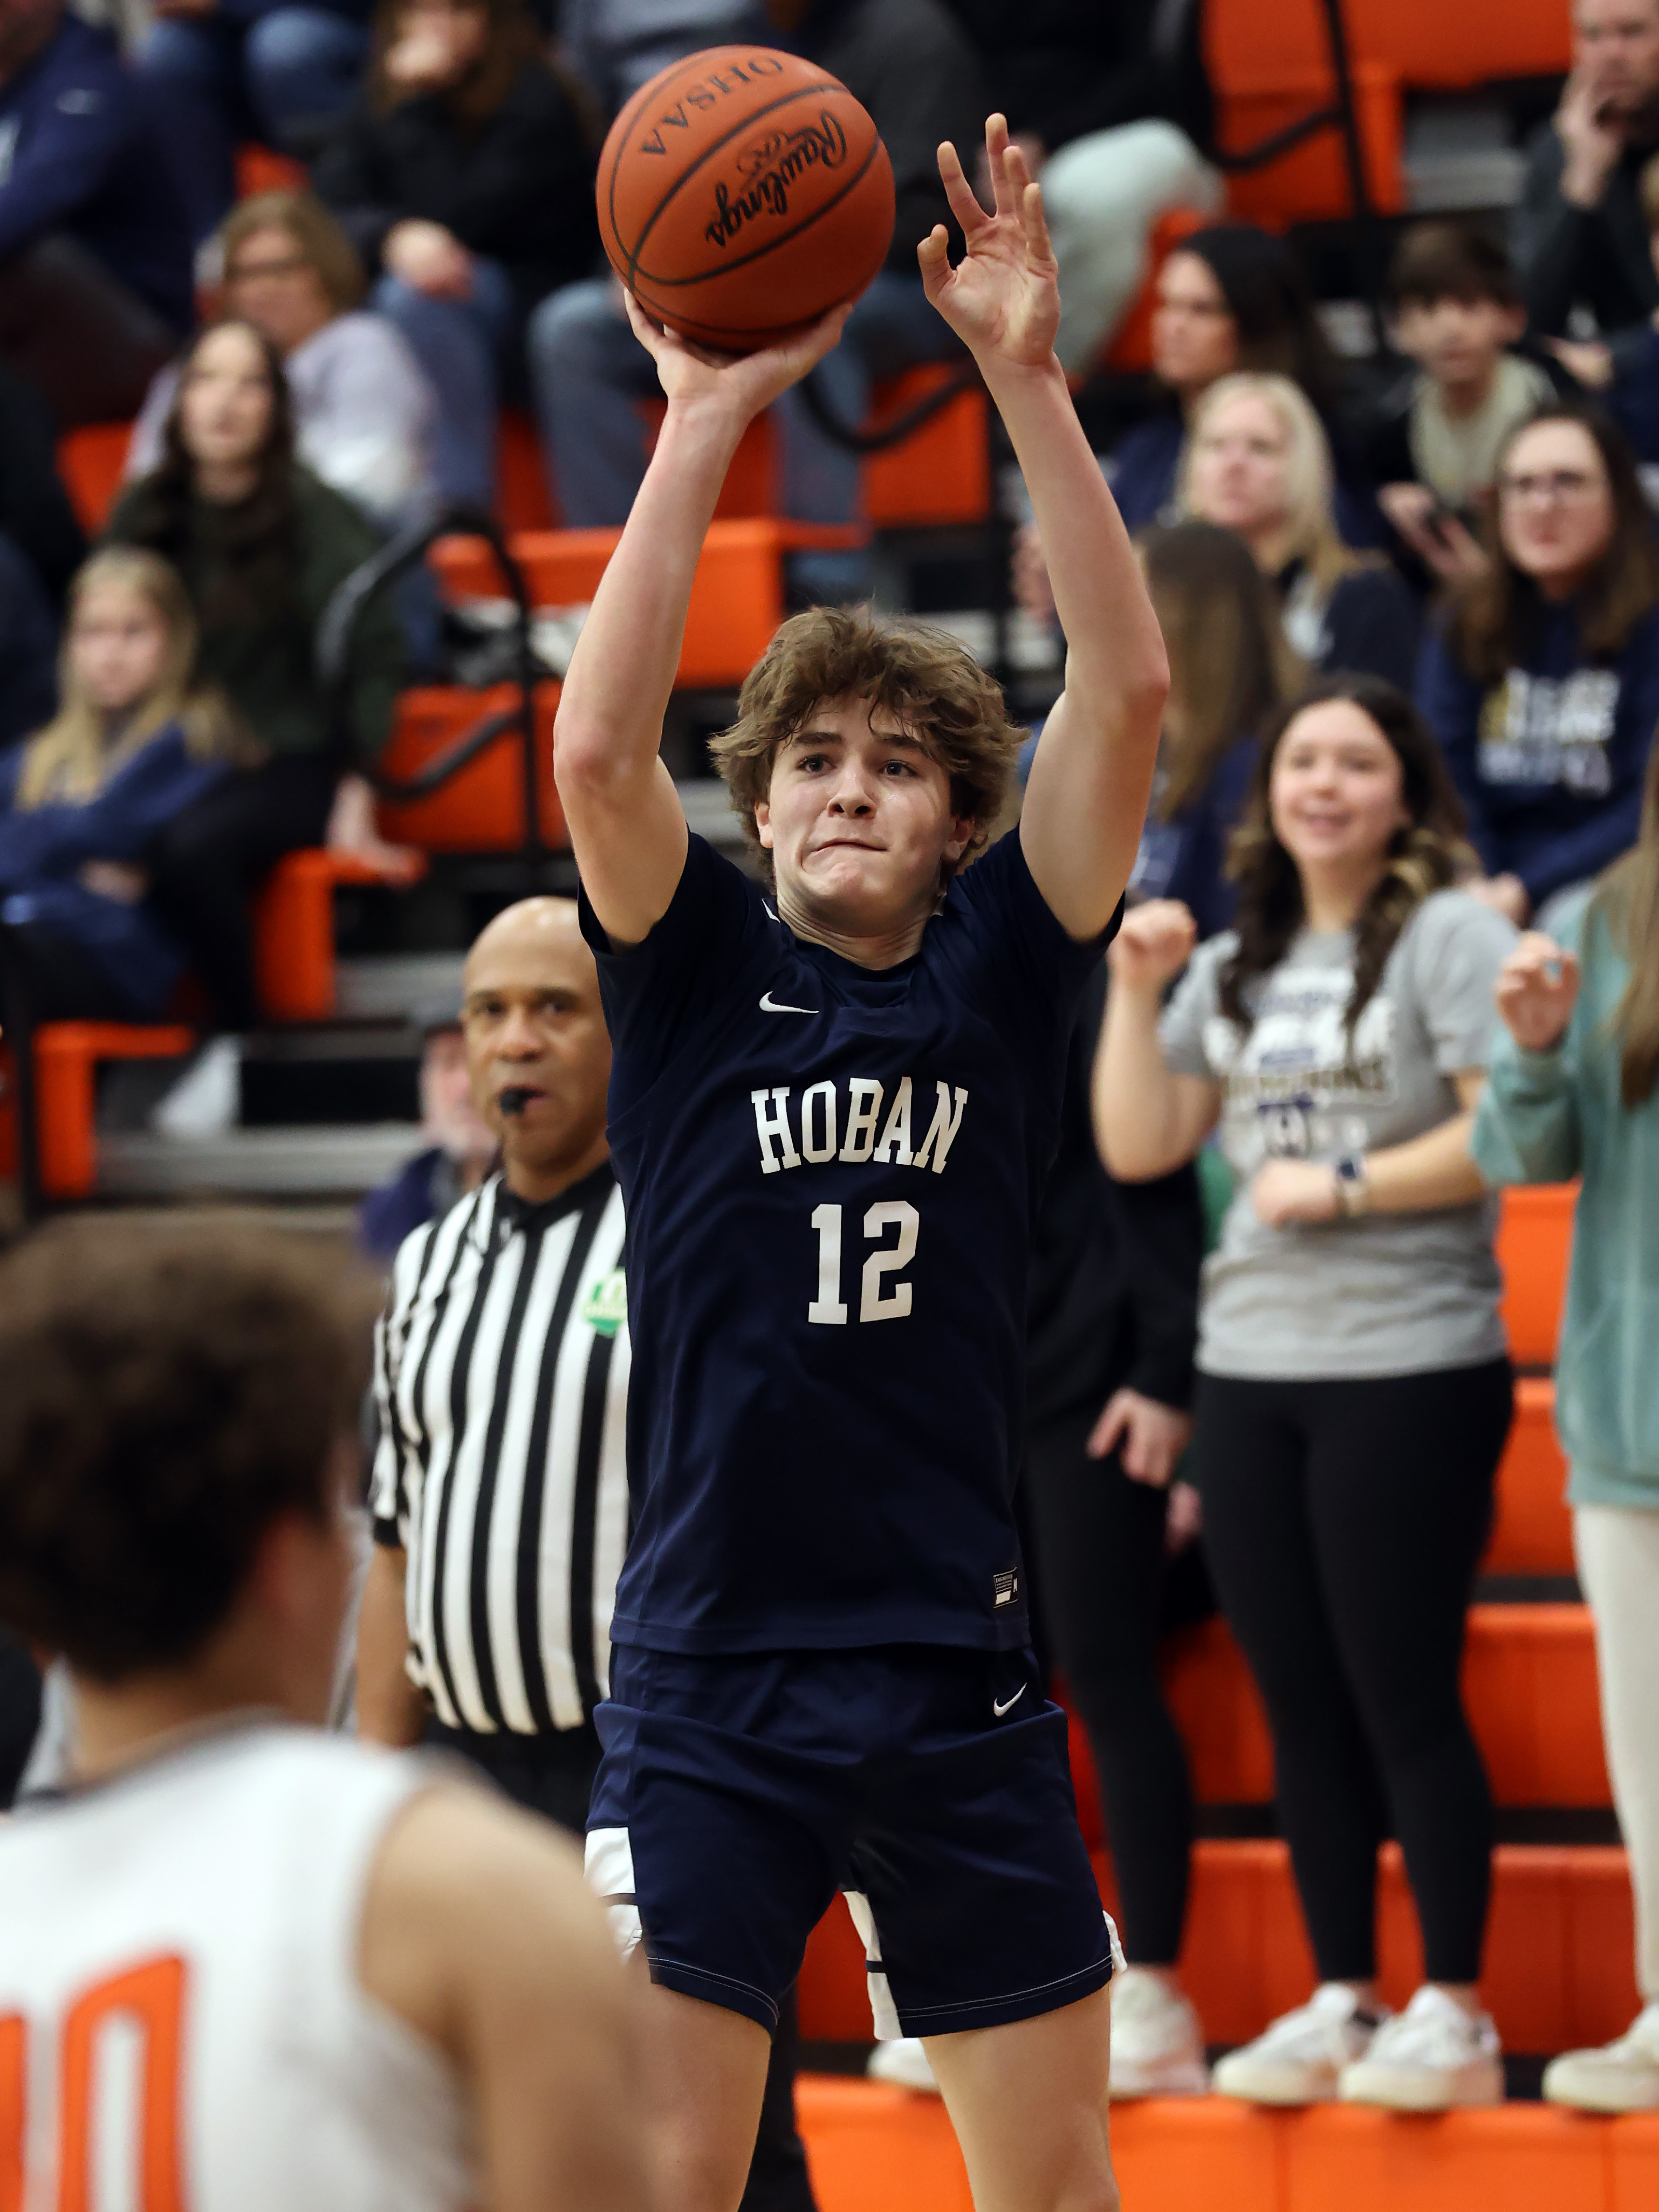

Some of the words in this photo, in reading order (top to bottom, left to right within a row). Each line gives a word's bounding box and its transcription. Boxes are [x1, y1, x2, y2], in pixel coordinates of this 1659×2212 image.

[641, 57, 783, 156] OHSAA
[705, 108, 847, 247] Rawlings
[751, 1076, 969, 1174] HOBAN
[808, 1200, 920, 1325] 12
